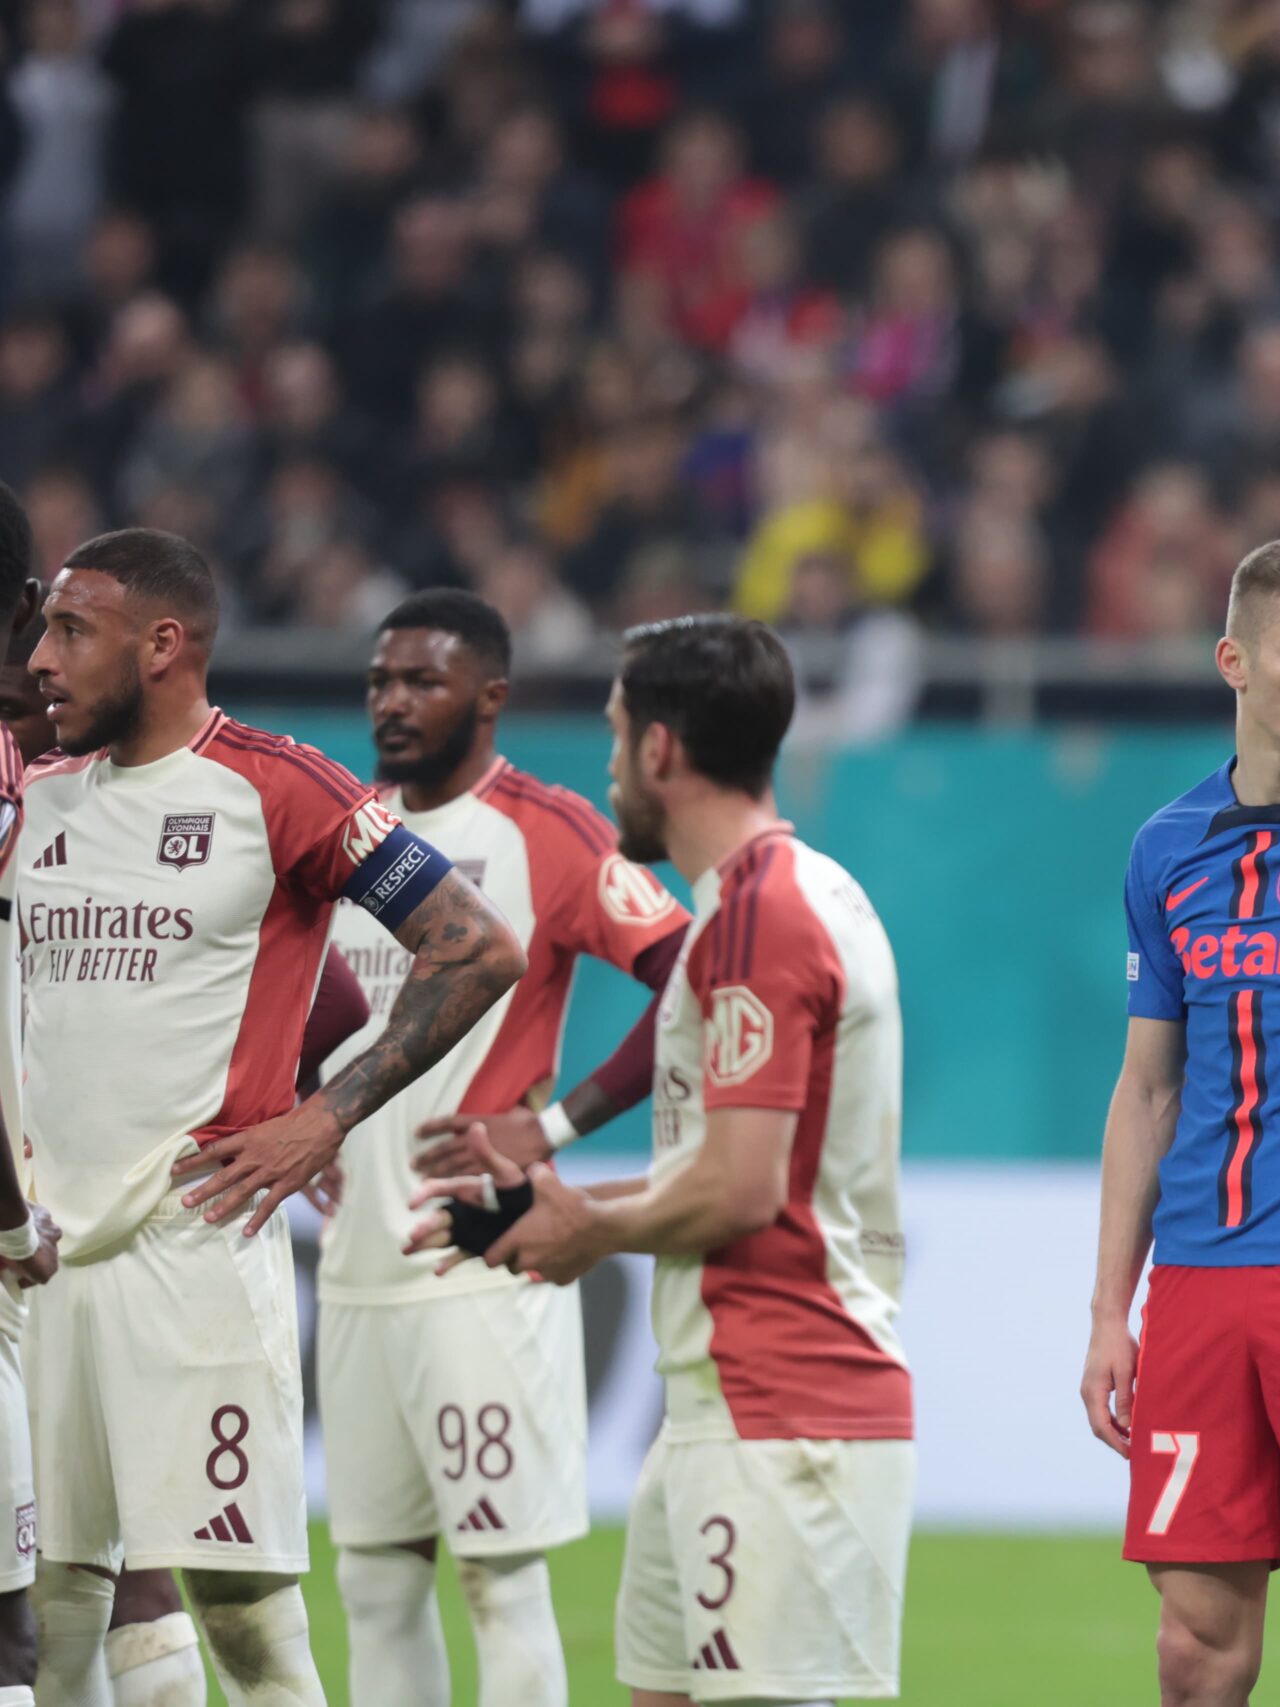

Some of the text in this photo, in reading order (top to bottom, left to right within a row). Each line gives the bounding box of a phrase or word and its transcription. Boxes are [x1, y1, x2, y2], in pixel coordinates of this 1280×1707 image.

[167, 824, 209, 832] LYONNAIS
[168, 817, 210, 825] OLYMPIQUE
[164, 836, 203, 859] OL
[374, 845, 425, 900] RESPECT
[30, 897, 194, 944] Emirates
[49, 948, 75, 983] FLY
[77, 948, 158, 982] BETTER
[206, 1404, 249, 1491] 8
[437, 1403, 514, 1482] 98
[1145, 1430, 1200, 1536] 7
[696, 1514, 737, 1610] 3
